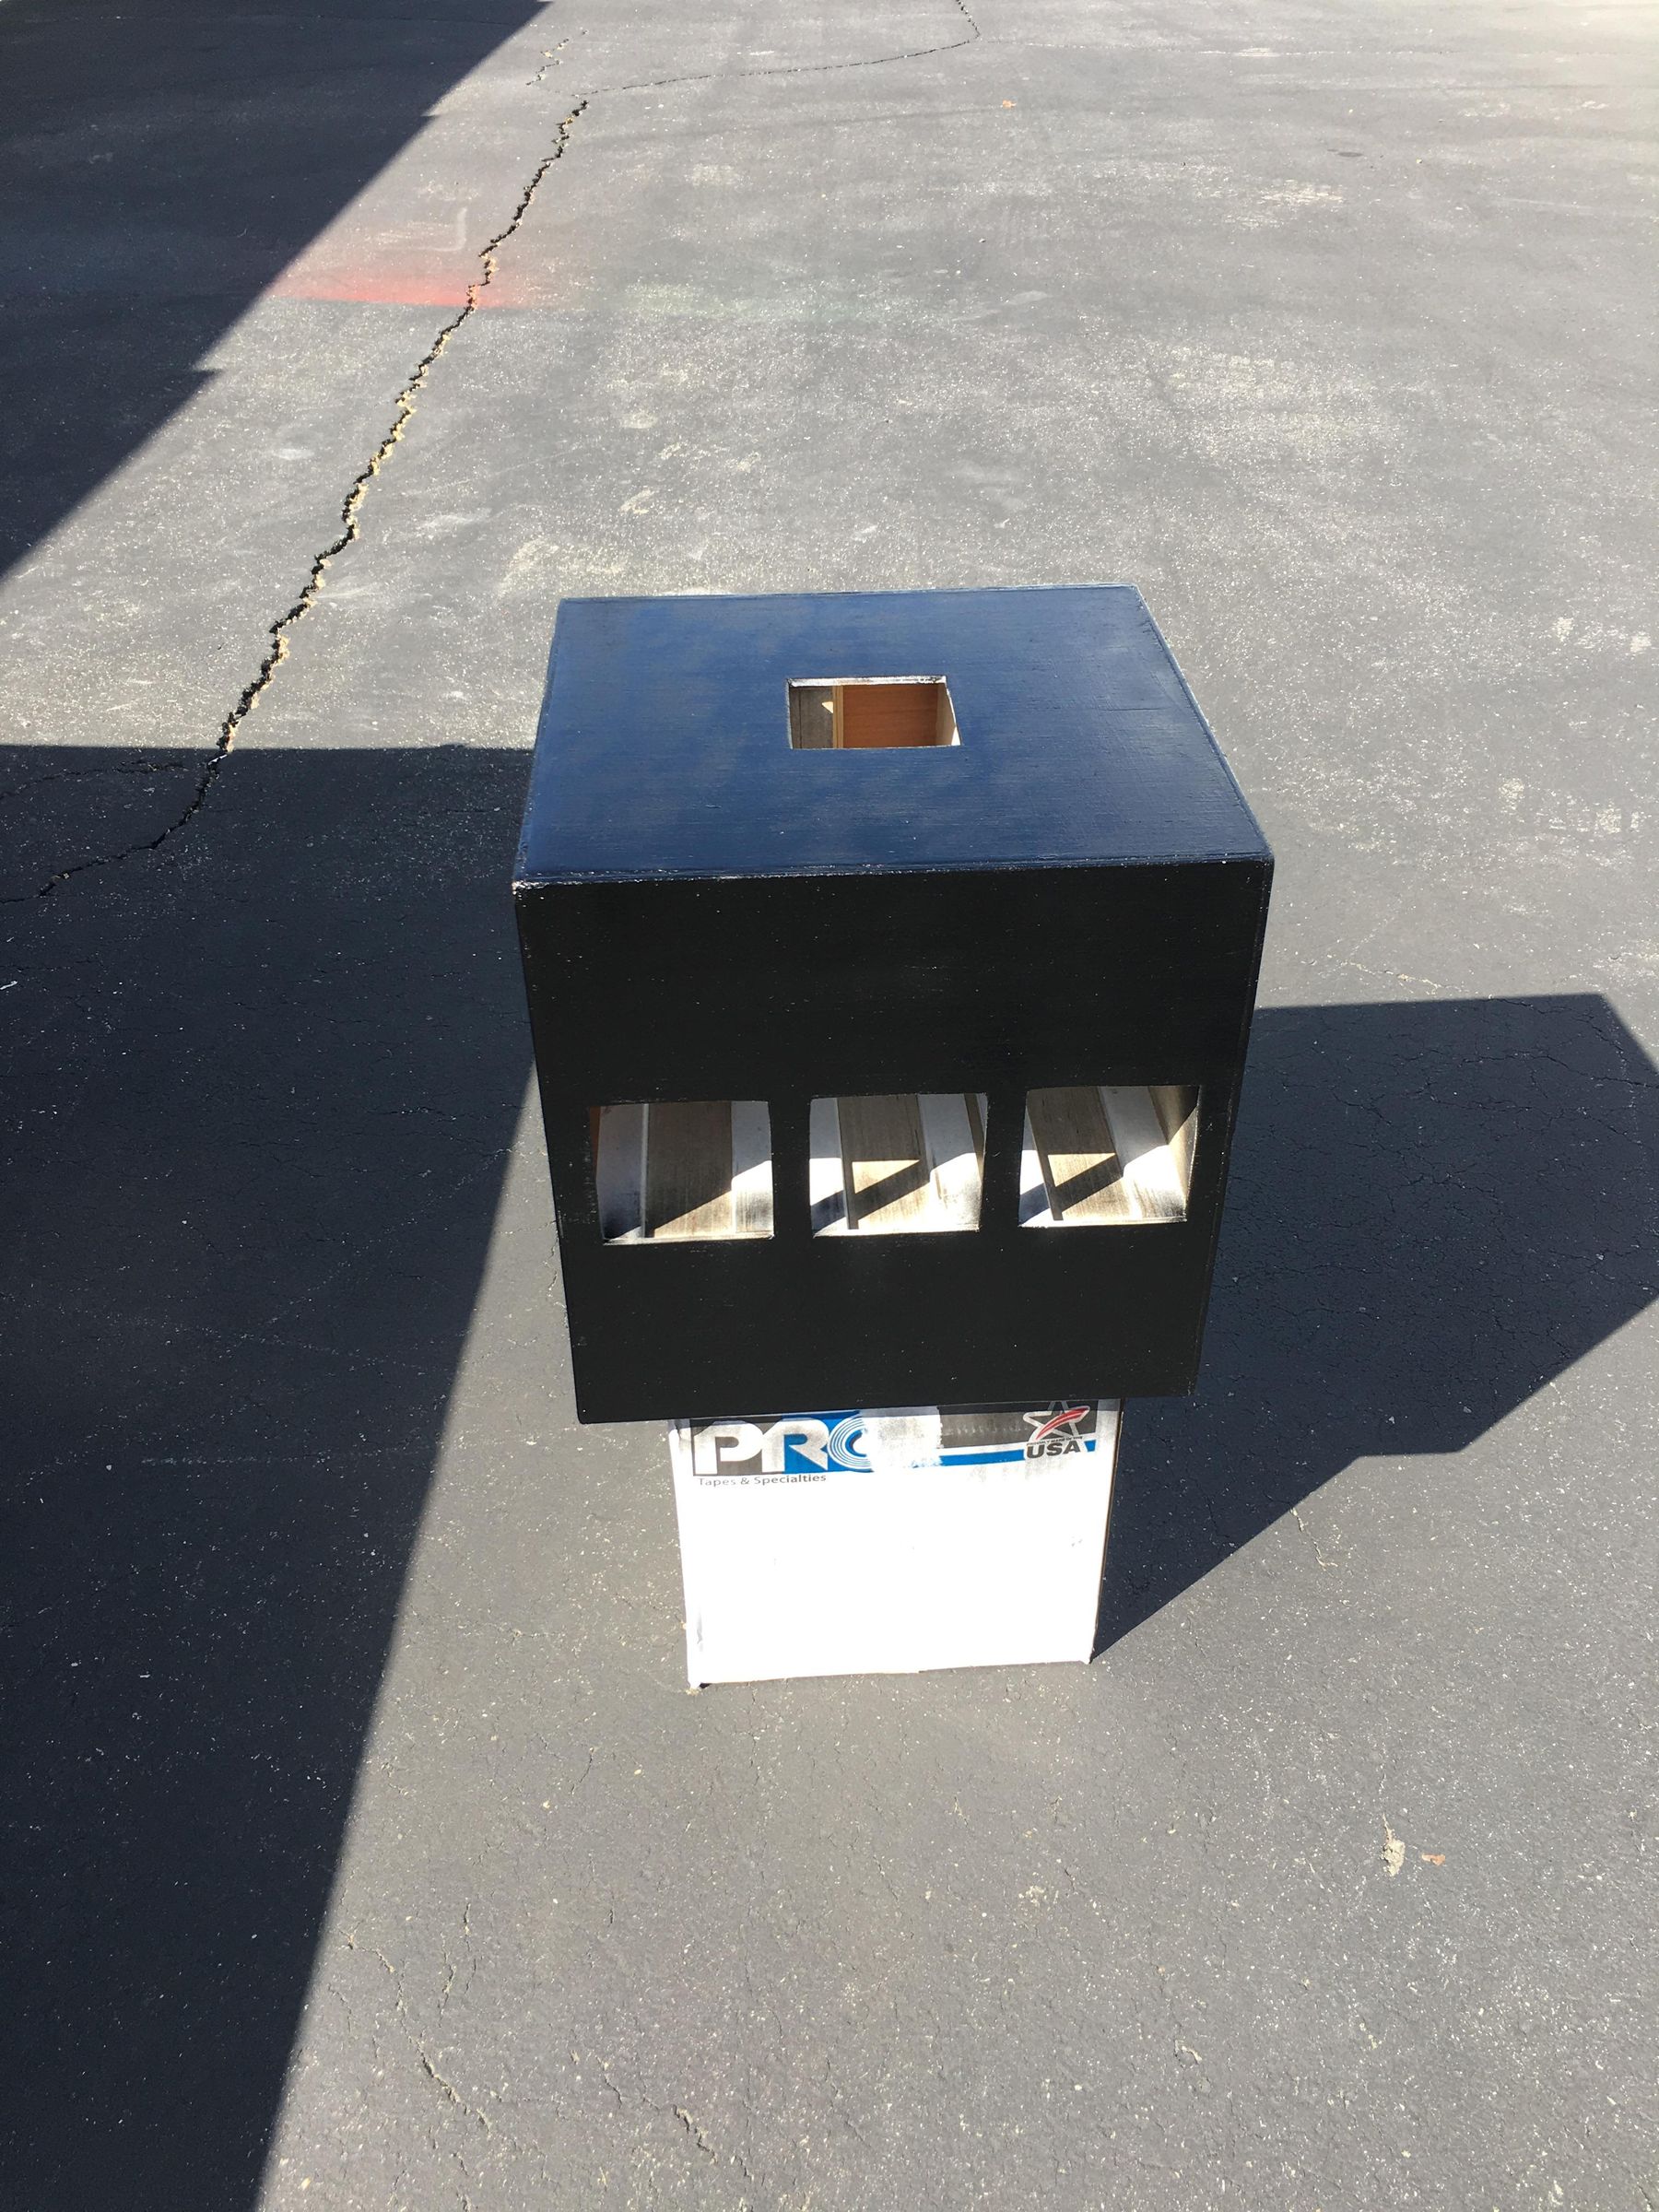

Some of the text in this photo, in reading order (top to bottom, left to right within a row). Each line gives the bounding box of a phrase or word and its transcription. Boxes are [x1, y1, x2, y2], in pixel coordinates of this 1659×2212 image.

[1027, 1440, 1081, 1458] USA
[699, 1474, 827, 1487] Tapes & Specialties
